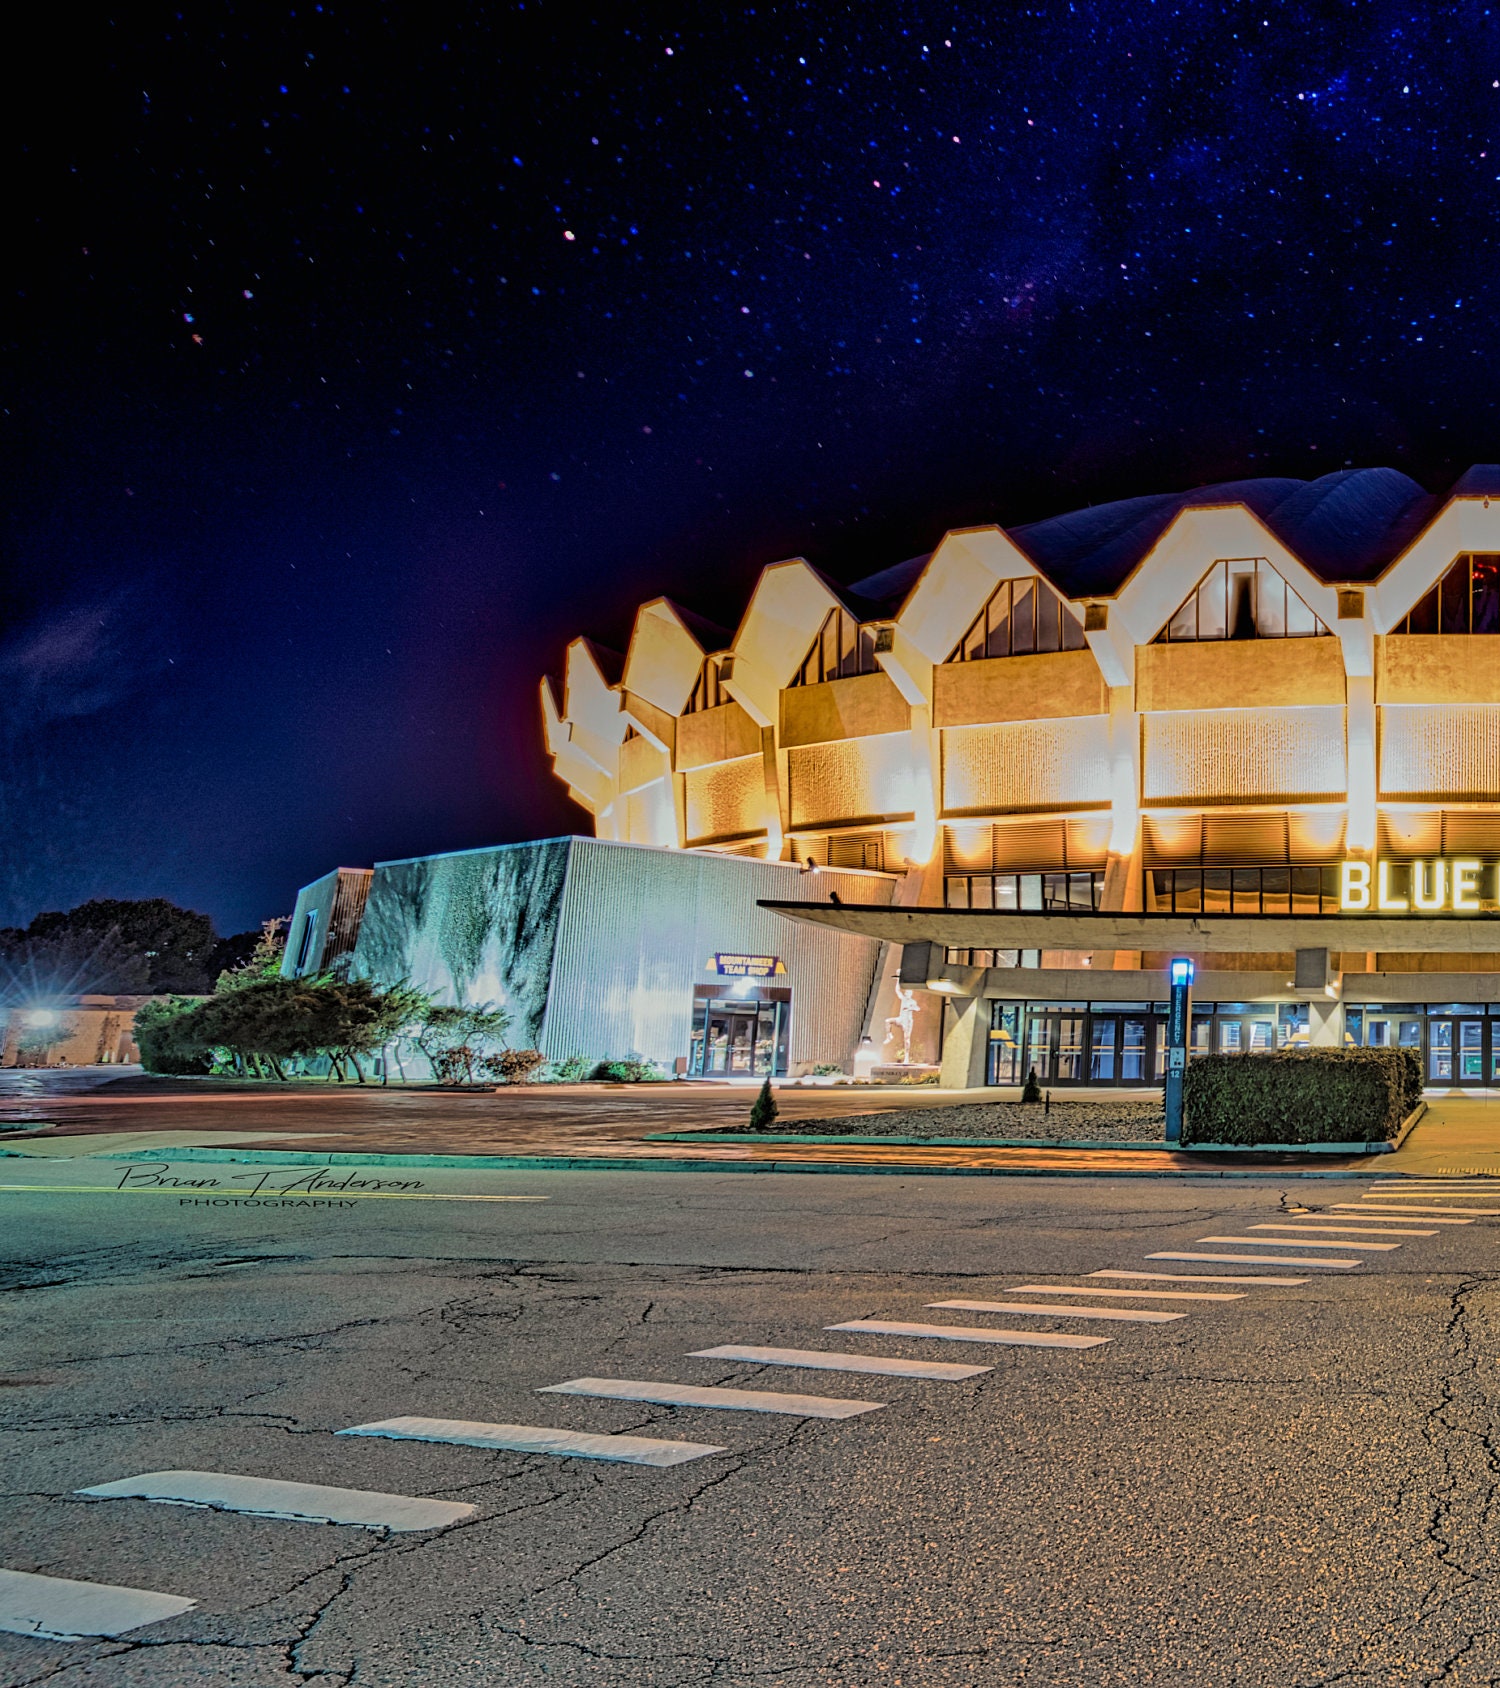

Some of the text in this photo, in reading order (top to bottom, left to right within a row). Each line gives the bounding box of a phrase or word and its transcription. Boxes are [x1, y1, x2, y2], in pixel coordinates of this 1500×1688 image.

[1340, 861, 1481, 910] BLUE
[719, 955, 774, 968] MOUNTAINEER
[724, 965, 769, 976] TEAM SHOP
[1174, 986, 1182, 1044] EMERGENCY
[1170, 1070, 1180, 1078] 12
